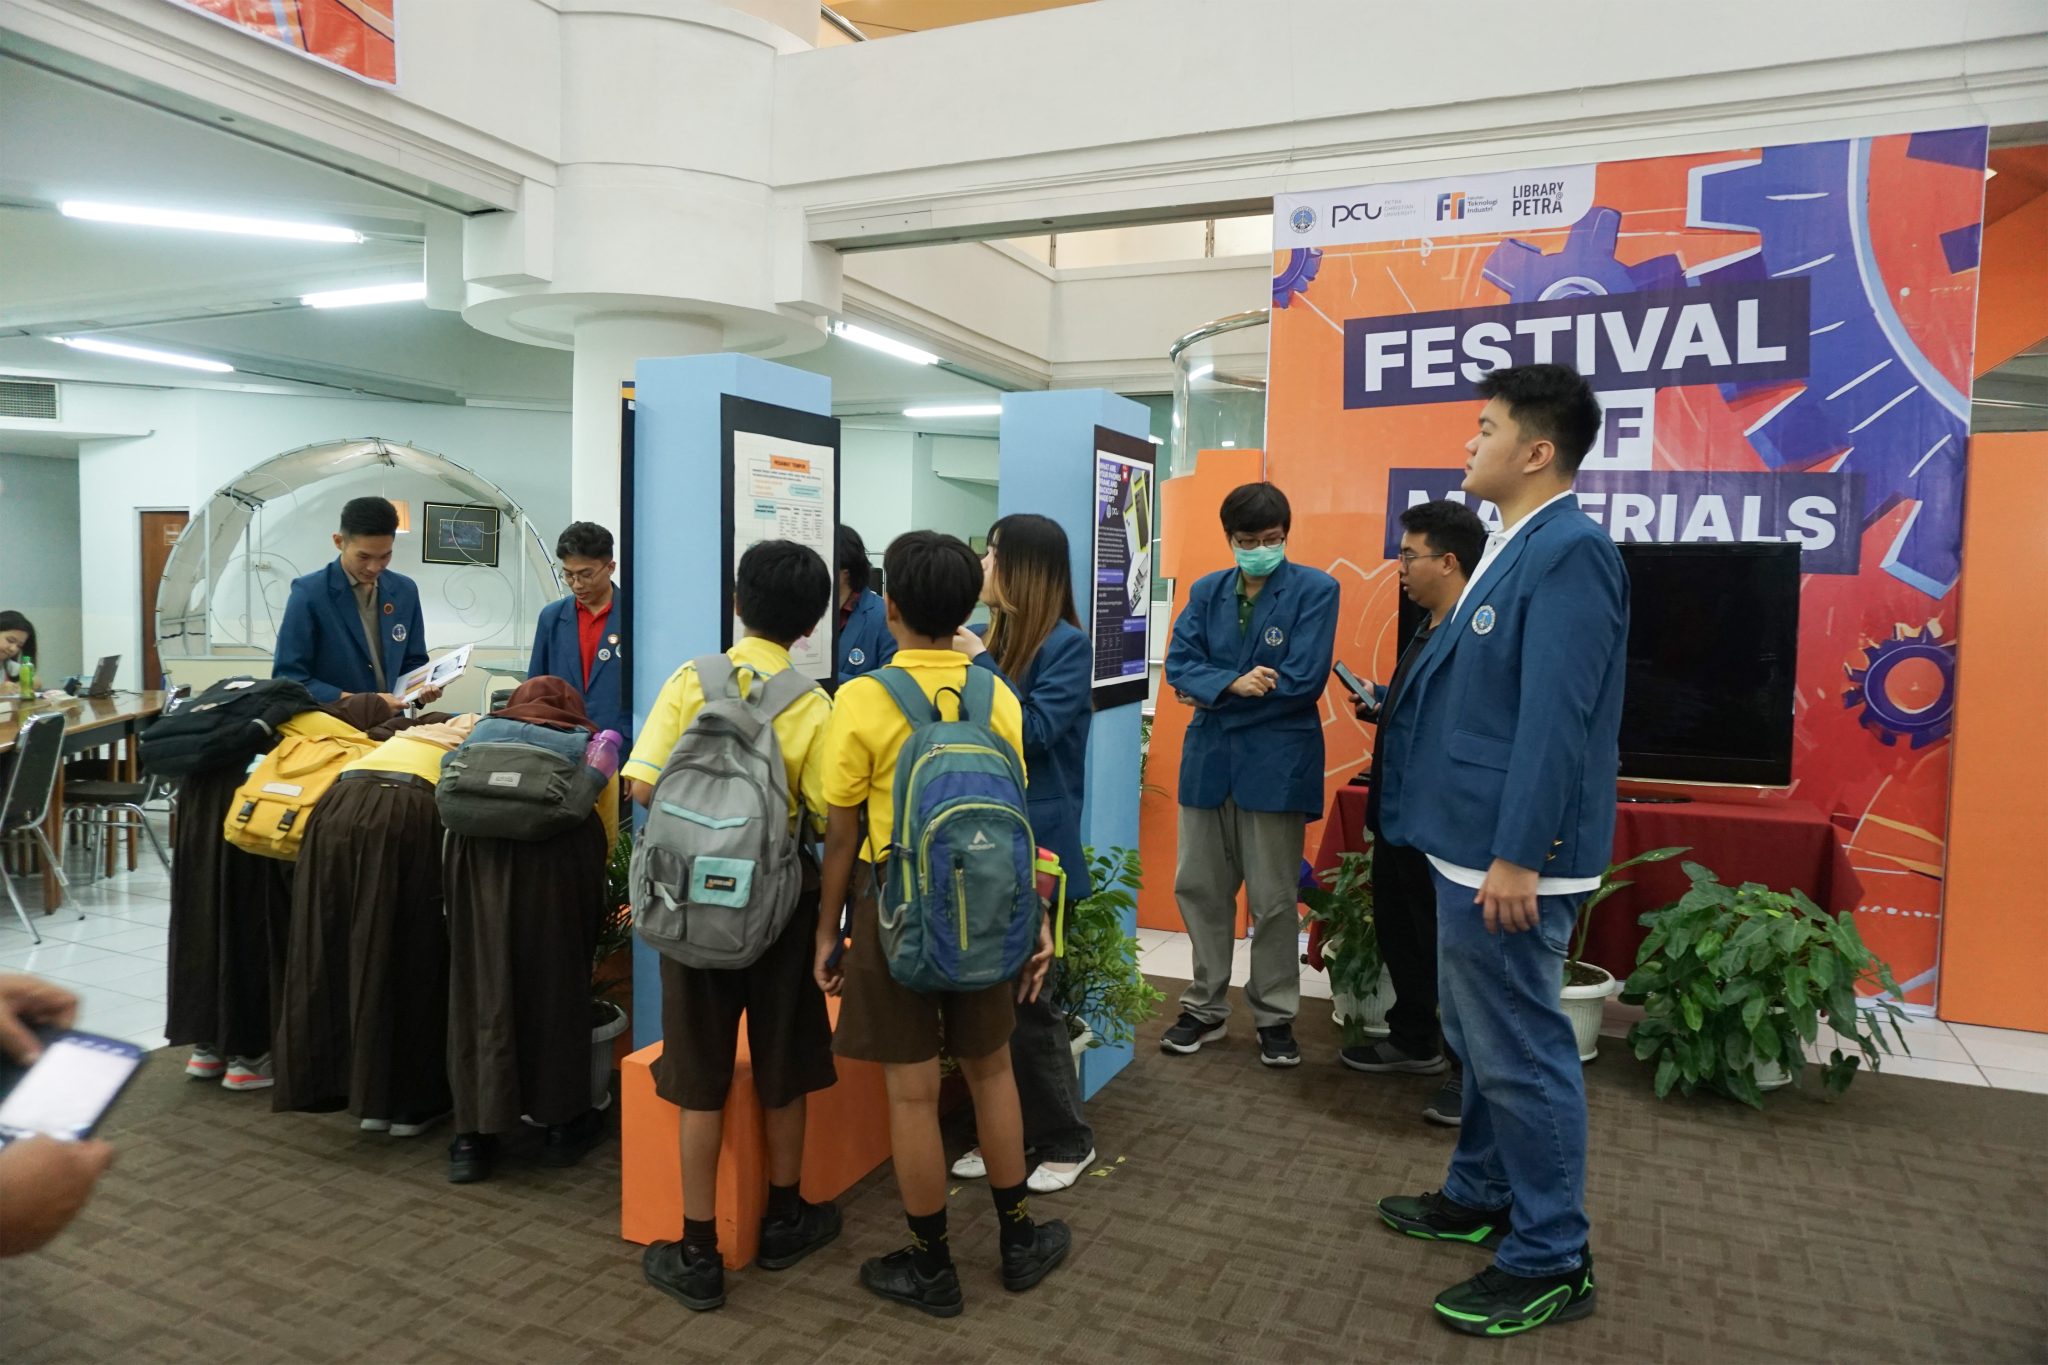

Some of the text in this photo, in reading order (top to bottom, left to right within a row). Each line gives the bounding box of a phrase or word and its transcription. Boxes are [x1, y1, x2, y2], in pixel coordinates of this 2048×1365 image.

[1513, 182, 1565, 198] LIBRARY
[1512, 198, 1563, 217] PETRA
[1365, 299, 1787, 392] FESTIVAL
